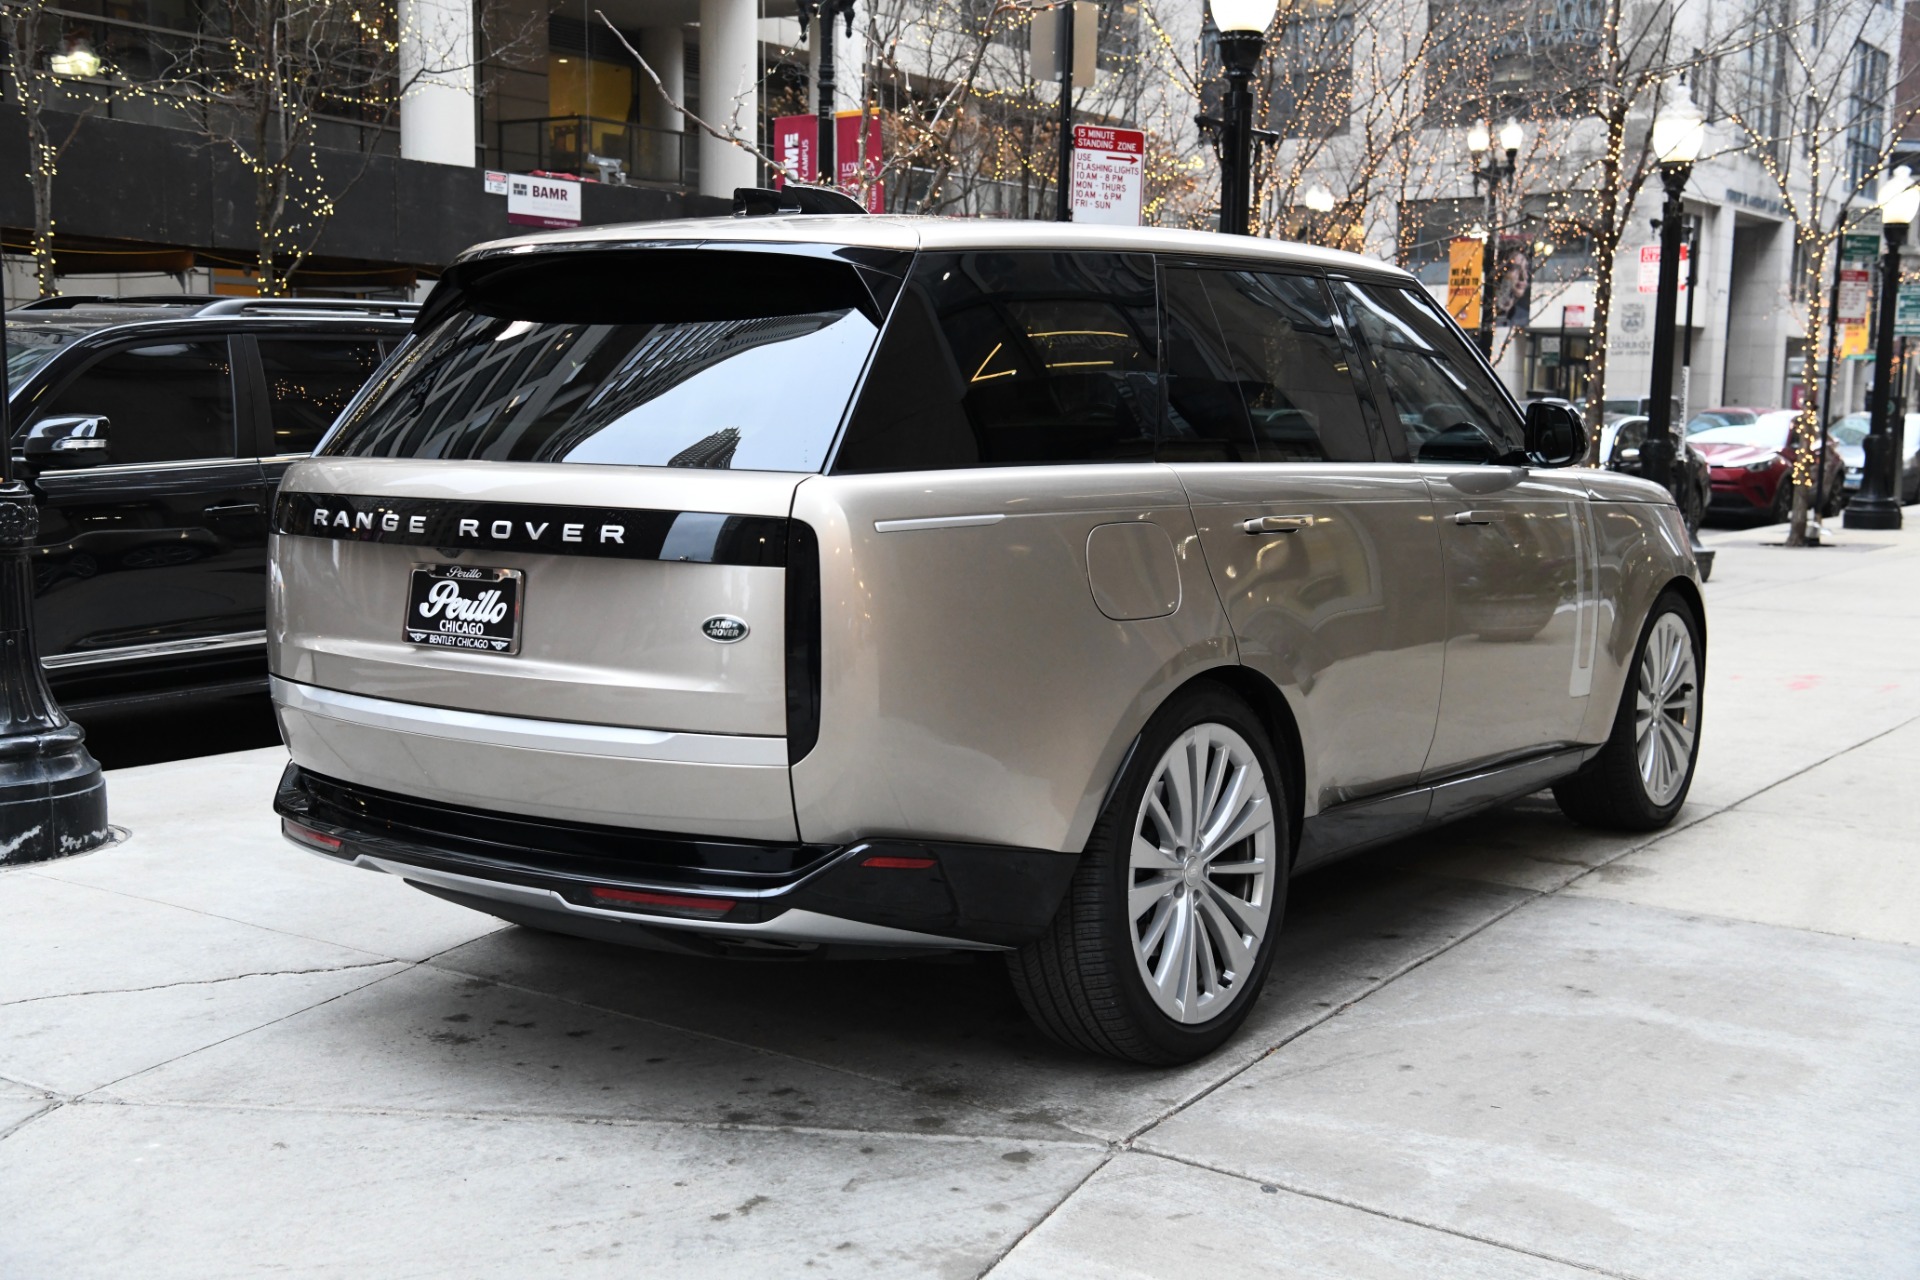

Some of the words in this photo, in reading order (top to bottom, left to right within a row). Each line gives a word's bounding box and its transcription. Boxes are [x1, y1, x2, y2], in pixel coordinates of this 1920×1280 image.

[1078, 128, 1086, 137] 15
[1087, 129, 1115, 140] MINUTE
[1077, 138, 1114, 149] STANDING
[1117, 141, 1137, 152] ZONE
[801, 139, 809, 178] CAMPUS
[1076, 152, 1092, 162] USE
[841, 160, 875, 172] LOYA
[1076, 162, 1113, 174] FLASHING
[1113, 164, 1139, 176] LIGHTS
[1086, 172, 1098, 180] AM
[1111, 174, 1123, 183] PM
[532, 185, 568, 201] BAMR
[1075, 180, 1093, 189] MON
[1101, 182, 1127, 193] THURS
[1084, 190, 1096, 199] AM
[1103, 192, 1109, 200] 6
[1110, 192, 1122, 201] PM
[1075, 198, 1088, 207] FRI
[1094, 200, 1111, 209] SUN
[313, 508, 427, 533] RANGE
[458, 519, 626, 544] ROVER
[446, 565, 482, 578] Perillo
[419, 580, 508, 624] Perillo
[439, 619, 484, 635] CHICAGO
[710, 620, 732, 629] LAND
[711, 629, 739, 637] ROVER
[428, 634, 456, 646] BENTLEY
[456, 636, 489, 649] CHICAGO
